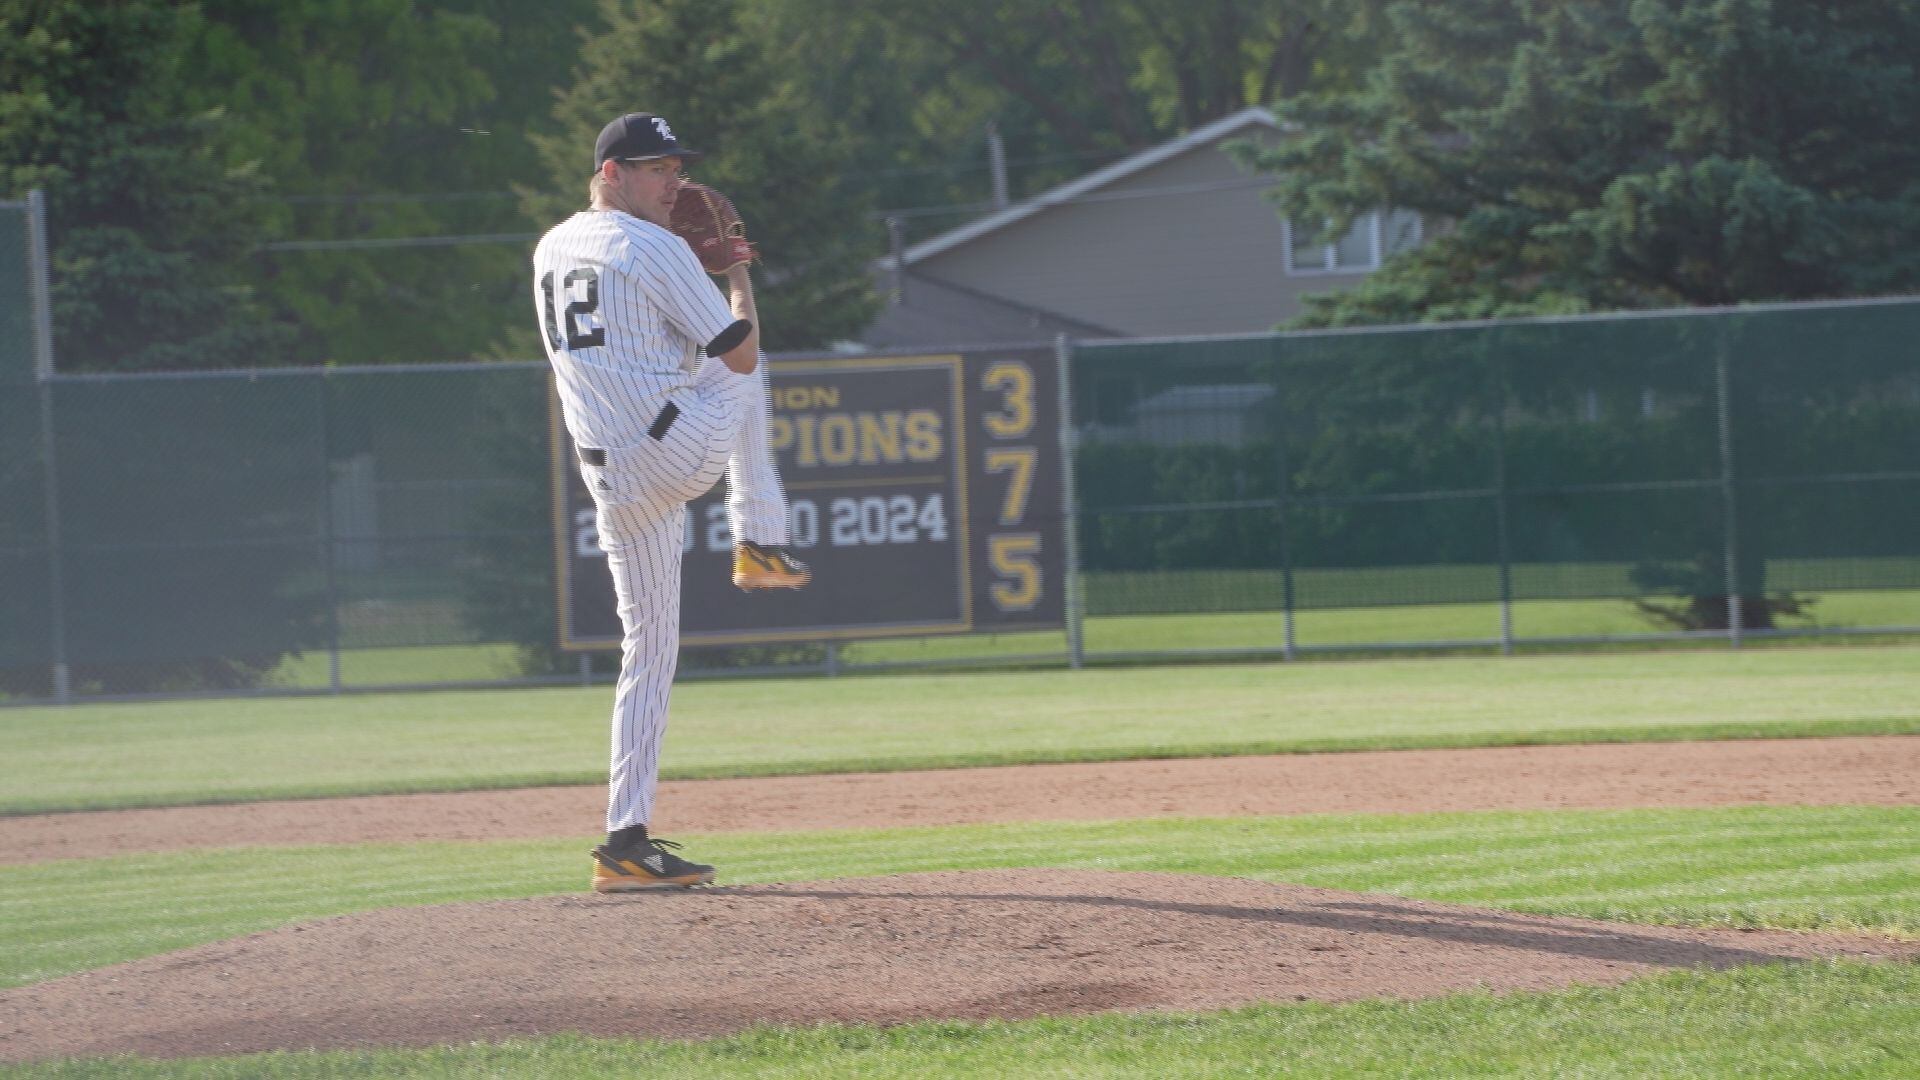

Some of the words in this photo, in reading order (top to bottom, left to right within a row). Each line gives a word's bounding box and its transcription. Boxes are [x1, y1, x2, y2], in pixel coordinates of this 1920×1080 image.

[541, 267, 605, 353] 12
[772, 411, 944, 465] PIONS
[705, 498, 819, 551] 20
[830, 493, 948, 545] 2024
